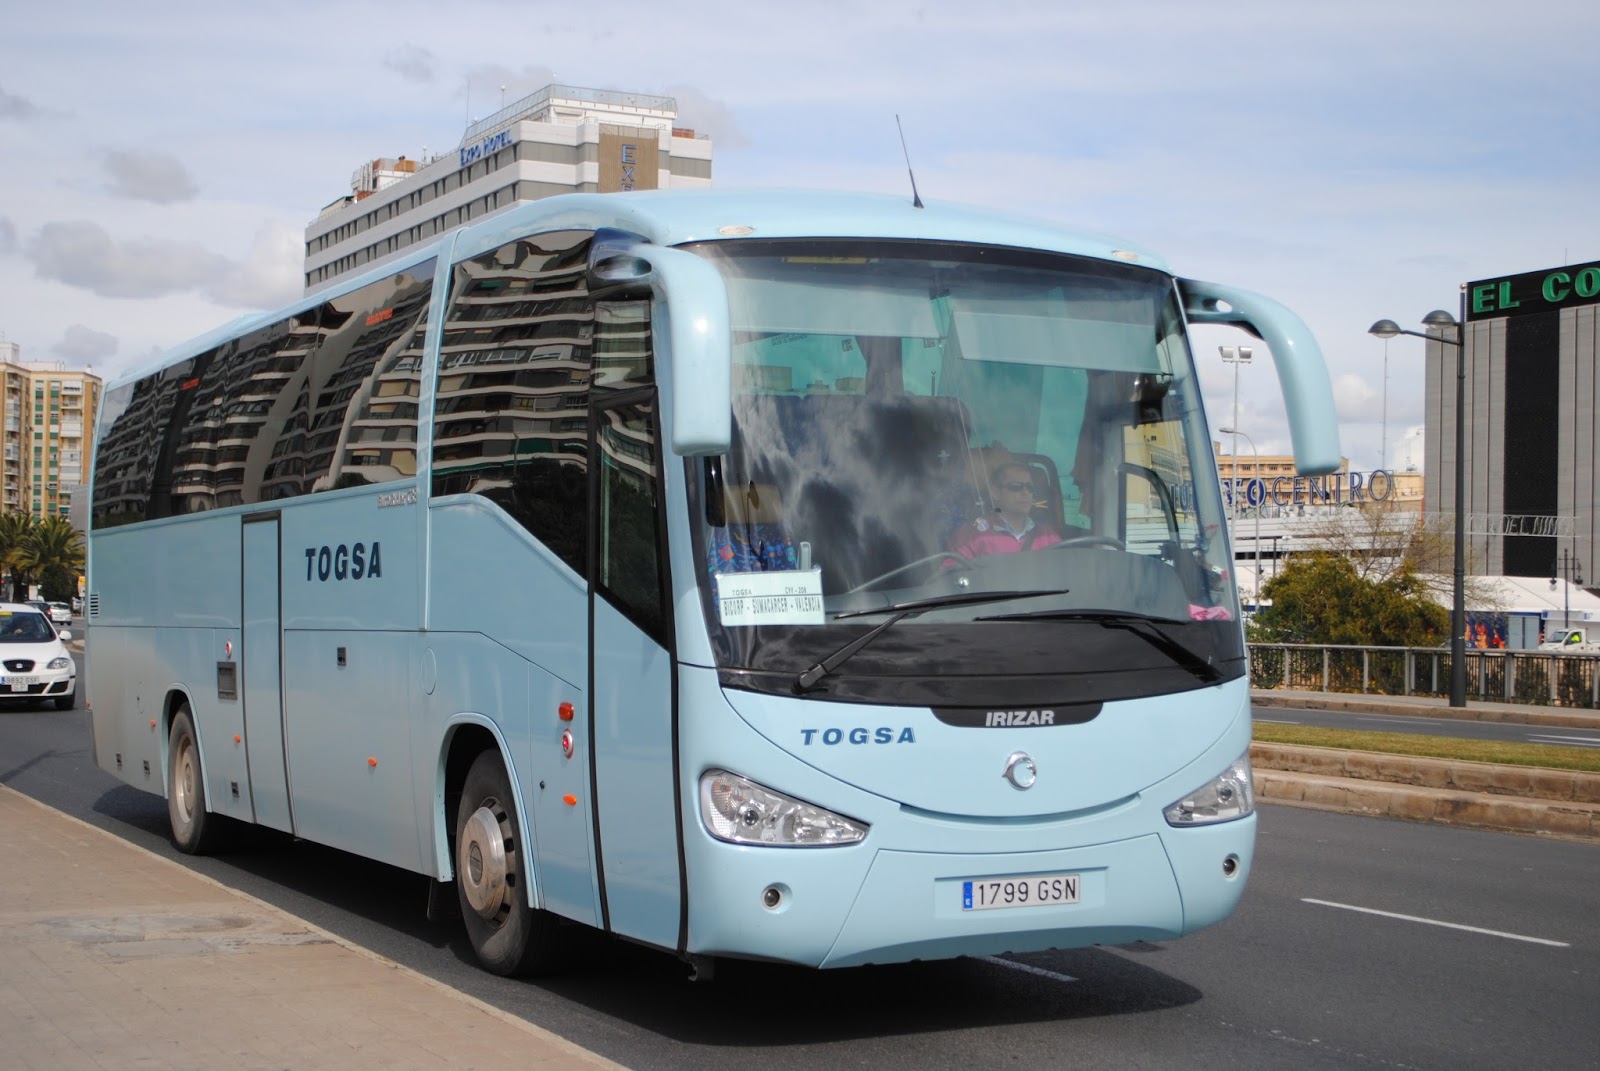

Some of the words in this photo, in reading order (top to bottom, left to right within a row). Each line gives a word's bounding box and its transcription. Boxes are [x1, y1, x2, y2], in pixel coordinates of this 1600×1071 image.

[483, 129, 512, 157] HOTEL
[1472, 281, 1520, 313] EL
[305, 541, 382, 582] TOGSA
[795, 597, 821, 613] VALENCIA
[985, 710, 1055, 727] IRIZAR
[801, 727, 916, 746] TOGSA
[978, 882, 1029, 905] 1799
[1037, 878, 1077, 901] GSN
